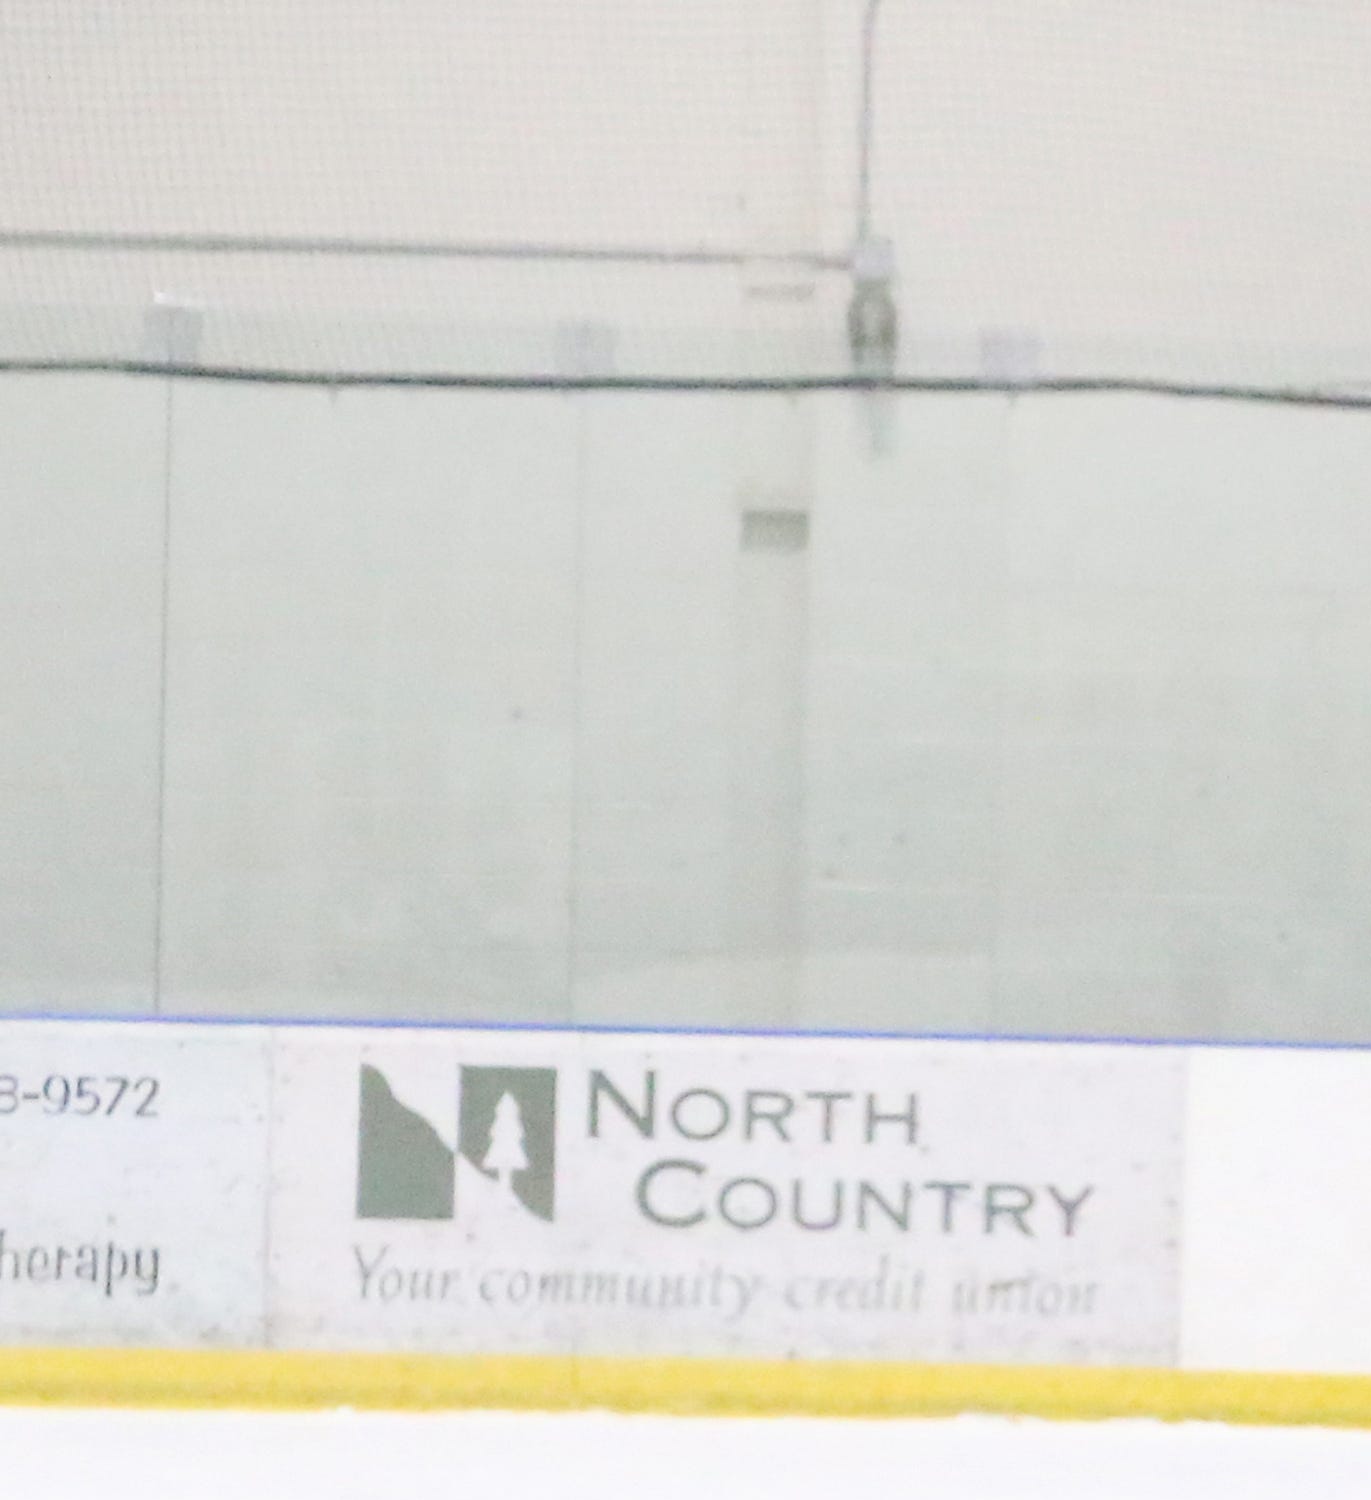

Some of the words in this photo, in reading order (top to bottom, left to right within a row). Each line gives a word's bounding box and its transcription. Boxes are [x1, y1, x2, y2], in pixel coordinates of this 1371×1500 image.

[351, 1243, 458, 1303] Your
[477, 1256, 755, 1317] community
[788, 1253, 924, 1313] credit
[950, 1278, 1098, 1315] union
